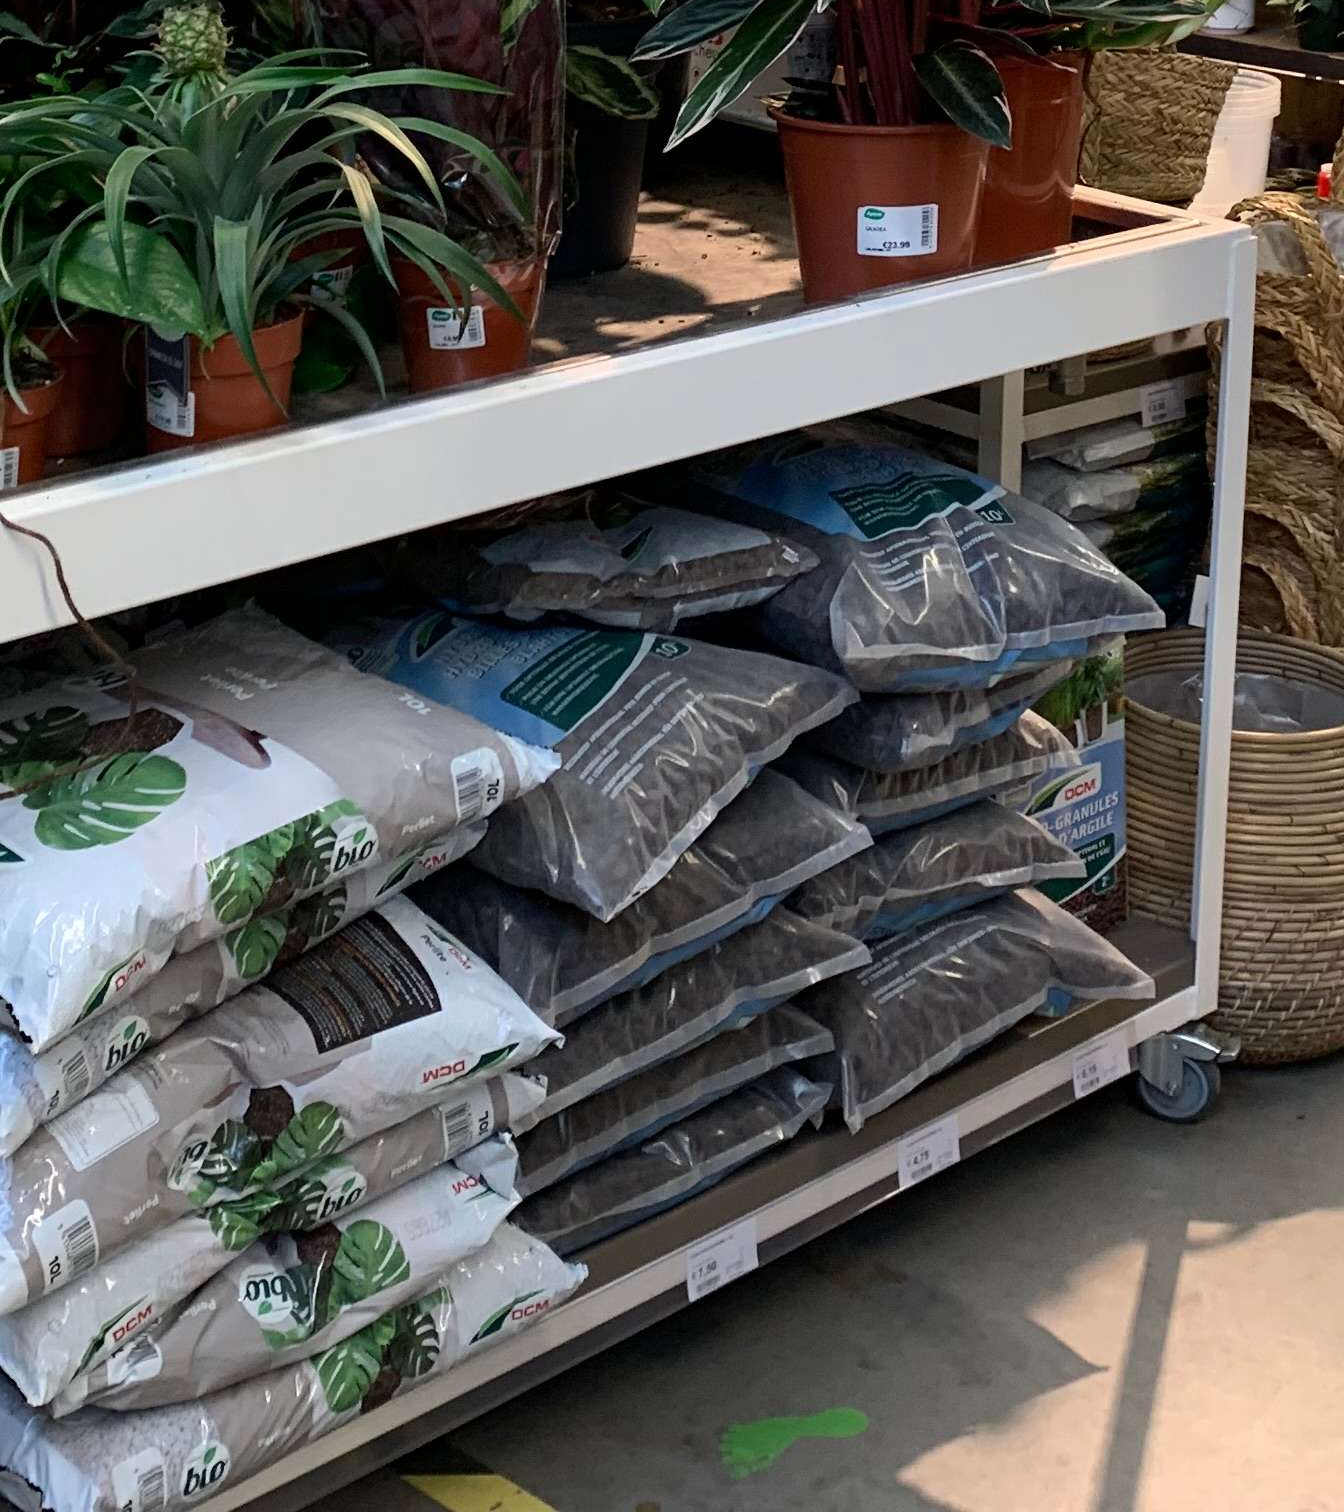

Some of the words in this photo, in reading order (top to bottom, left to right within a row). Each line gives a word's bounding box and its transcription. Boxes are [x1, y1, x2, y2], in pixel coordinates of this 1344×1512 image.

[882, 240, 911, 249] €23.99
[399, 692, 433, 716] 10L
[486, 778, 500, 803] 10L
[1063, 777, 1097, 801] DCM
[1057, 811, 1114, 846] D'ARGILE
[333, 839, 377, 873] bio
[105, 1031, 149, 1072] bio
[422, 1059, 465, 1085] DCM
[477, 1110, 489, 1136] 10L
[318, 1187, 363, 1219] bio
[47, 1255, 63, 1284] 10L
[245, 1275, 292, 1303] bio
[112, 1304, 154, 1344] DCM
[511, 1299, 551, 1321] DCM
[183, 1460, 227, 1497] bio
